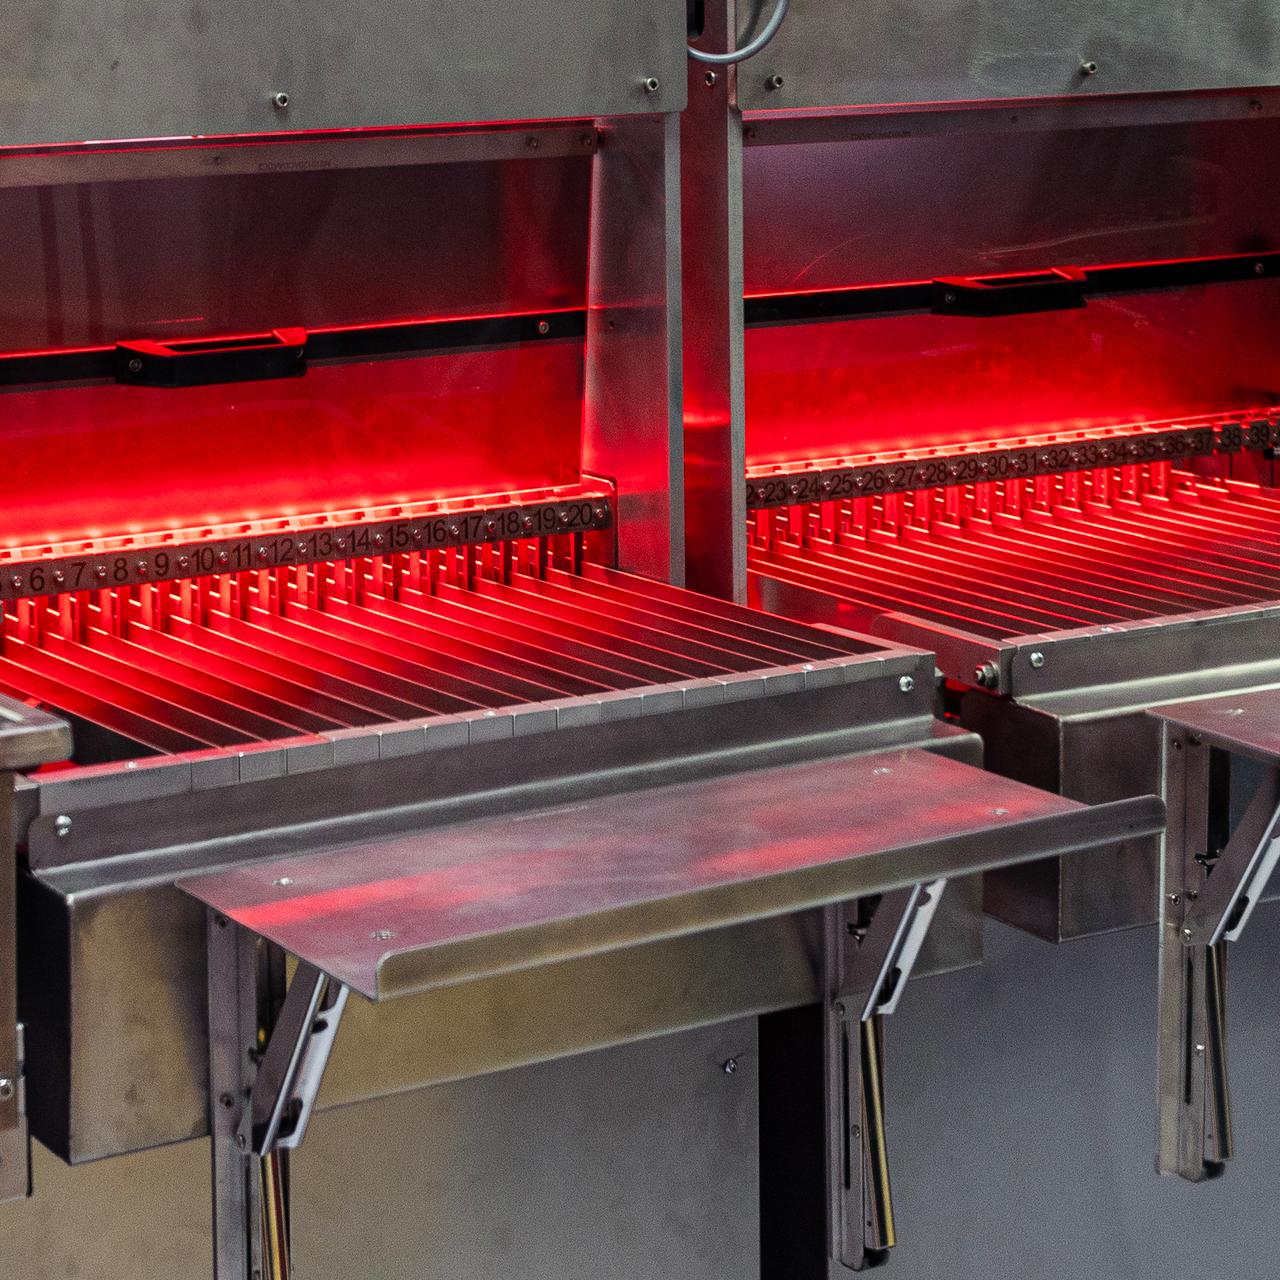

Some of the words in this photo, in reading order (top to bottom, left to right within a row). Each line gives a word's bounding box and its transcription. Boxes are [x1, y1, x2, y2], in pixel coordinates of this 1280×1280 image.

[765, 481, 787, 503] 23
[798, 478, 820, 500] 24
[830, 473, 852, 496] 25
[863, 469, 885, 491] 26
[895, 466, 916, 487] 27
[926, 462, 948, 483] 28
[957, 459, 978, 480] 29
[987, 455, 1008, 476] 30
[1018, 452, 1037, 472] 31
[1048, 448, 1069, 468] 32
[1077, 444, 1098, 465] 33
[1106, 441, 1126, 460] 34
[30, 567, 44, 591] 6
[71, 562, 86, 586] 7
[114, 558, 128, 581] 8
[155, 552, 169, 576] 9
[191, 547, 214, 572] 10
[232, 543, 252, 567] 11
[270, 538, 293, 563] 12
[309, 532, 332, 557] 13
[346, 527, 370, 552] 14
[385, 523, 409, 548] 15
[423, 520, 447, 544] 16
[461, 515, 483, 540] 17
[498, 511, 520, 535] 18
[534, 507, 556, 531] 19
[569, 503, 593, 527] 20
